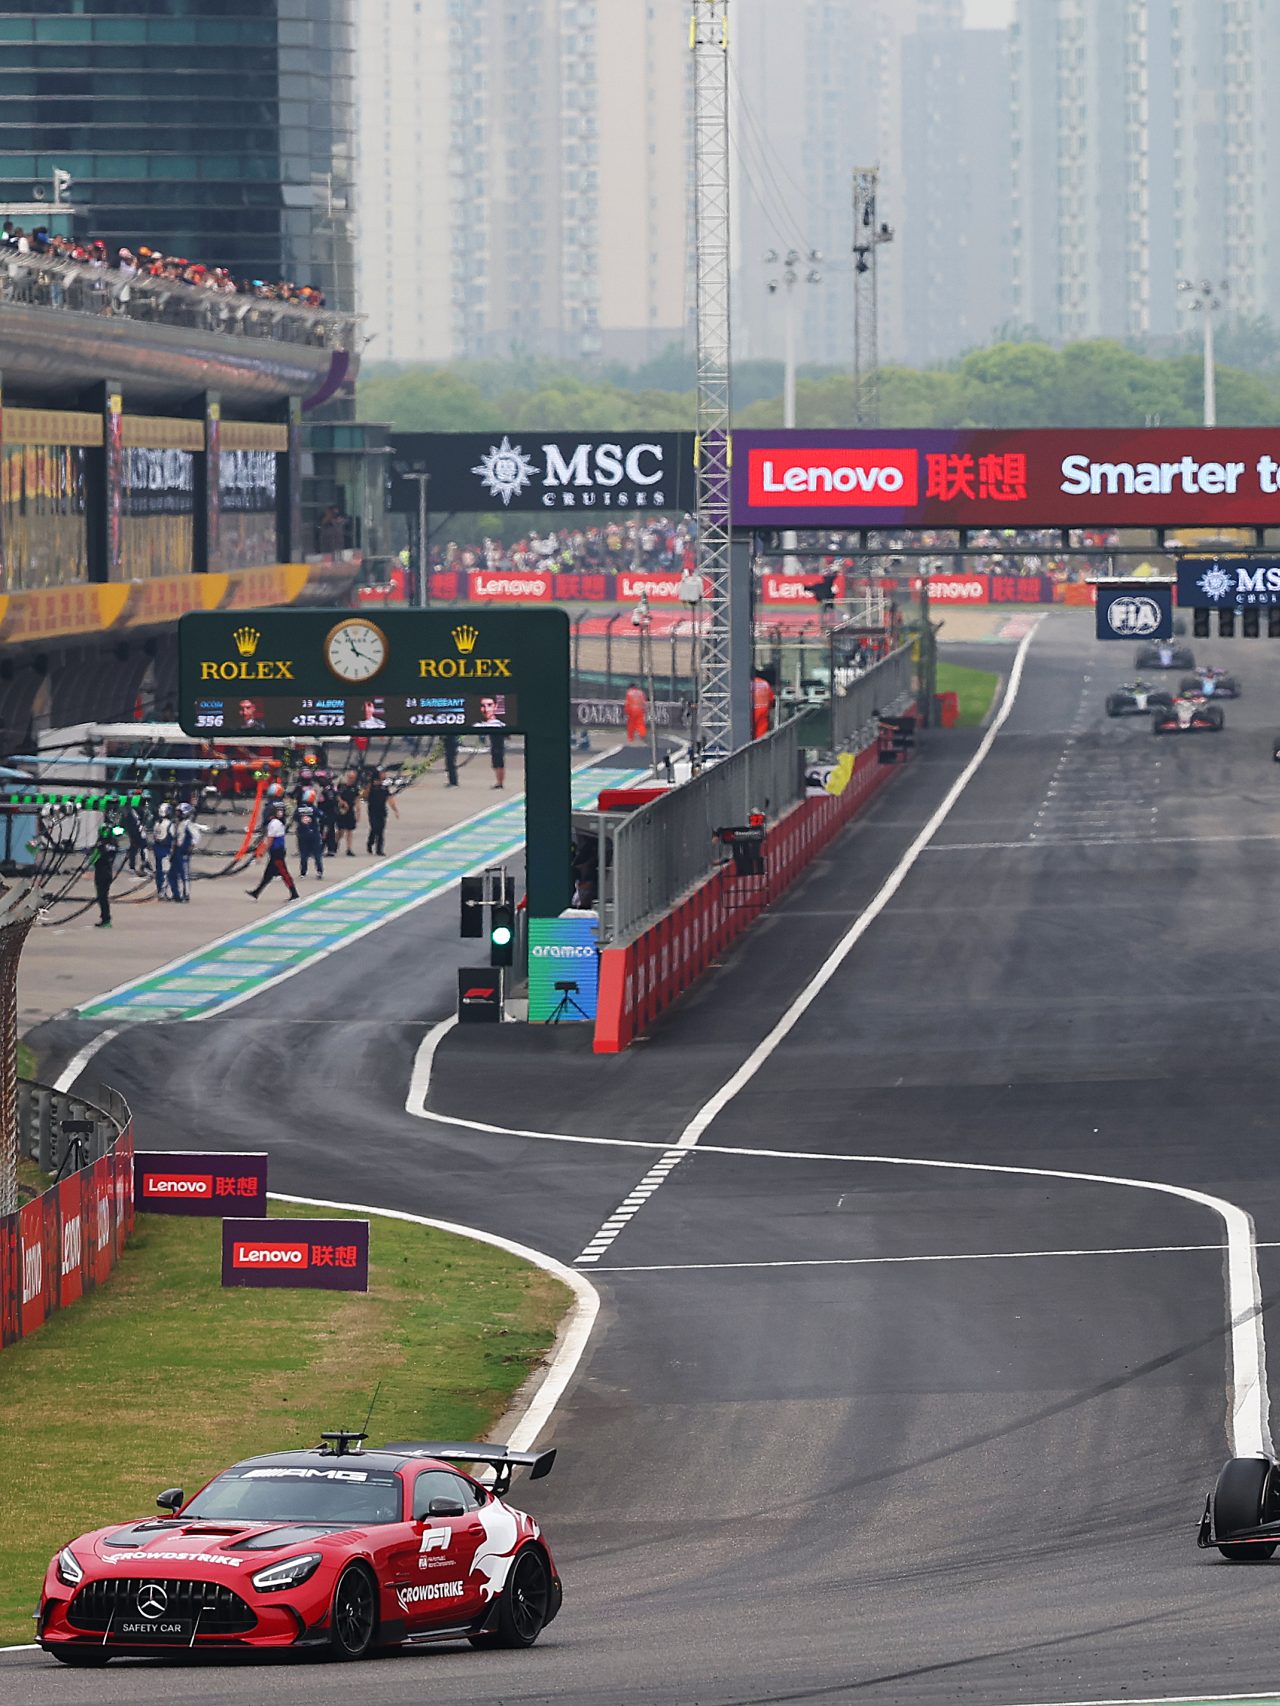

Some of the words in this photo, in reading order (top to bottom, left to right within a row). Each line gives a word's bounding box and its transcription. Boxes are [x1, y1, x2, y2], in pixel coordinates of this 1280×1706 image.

[541, 444, 664, 487] MSC
[1060, 455, 1244, 495] Smarter
[763, 461, 903, 493] Lenovo
[925, 453, 1027, 501] 联想
[542, 492, 665, 506] CRUISES
[475, 577, 546, 597] Lenovo
[622, 577, 682, 597] Lenov
[1112, 604, 1156, 627] FIA
[200, 660, 295, 680] ROLEX
[418, 658, 513, 678] ROLEX
[532, 945, 595, 958] aramco
[148, 1178, 207, 1193] Lenovo
[216, 1177, 258, 1197] 联想
[239, 1247, 302, 1263] Lenovo
[311, 1245, 357, 1267] 联想
[277, 1468, 368, 1482] AMG
[418, 1526, 452, 1553] F1
[104, 1551, 244, 1568] CROWDSTRIKE
[400, 1580, 464, 1603] CROWDSTRIKE
[122, 1623, 157, 1633] SAFETY
[160, 1623, 182, 1633] CAR
